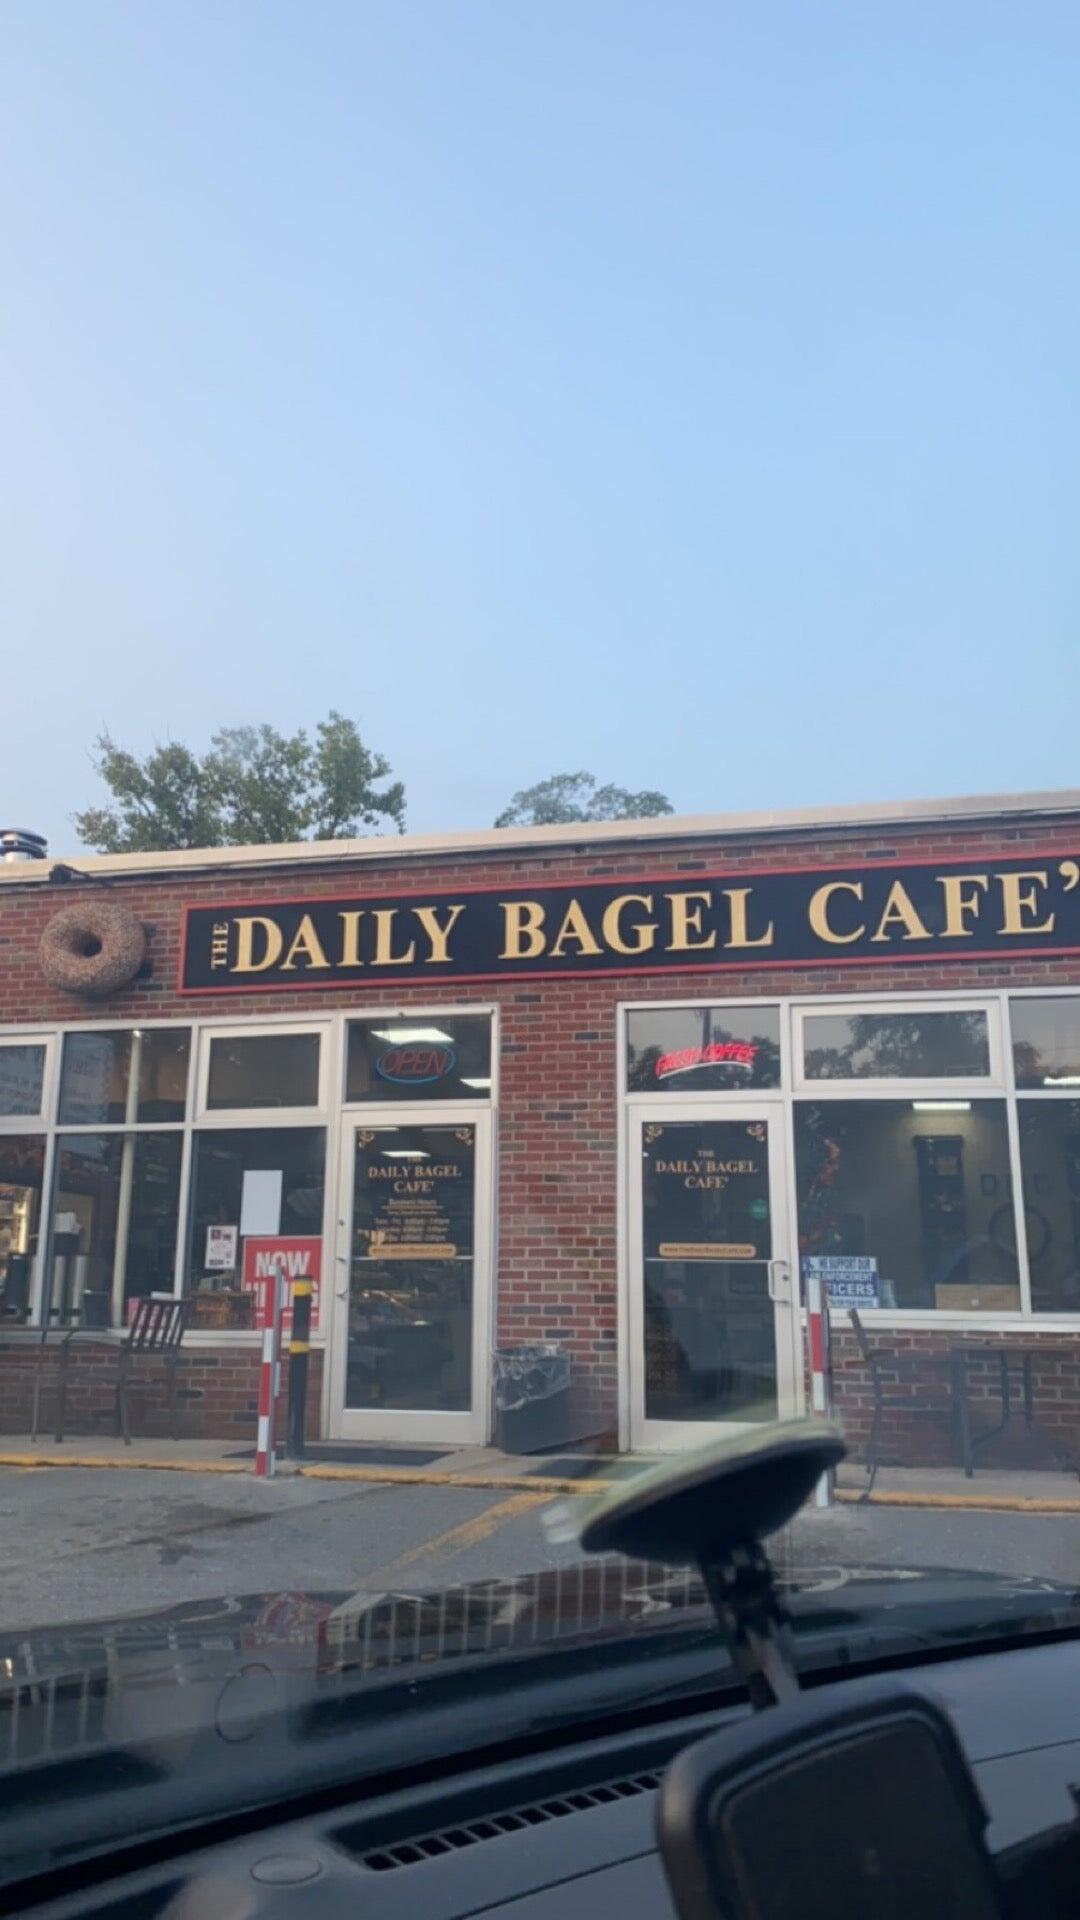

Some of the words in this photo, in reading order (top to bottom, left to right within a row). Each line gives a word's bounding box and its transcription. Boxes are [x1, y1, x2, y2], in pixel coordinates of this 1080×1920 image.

[211, 921, 229, 970] THE
[230, 905, 466, 972] DAILY
[498, 888, 774, 960] BAGEL
[381, 1050, 448, 1075] OPEN
[702, 1043, 759, 1064] COFFEE
[368, 1166, 410, 1179] DAILY
[415, 1165, 461, 1177] BAGEL
[655, 1160, 702, 1173] DAILY
[706, 1160, 758, 1173] BAGEL
[256, 1251, 311, 1278] NOW
